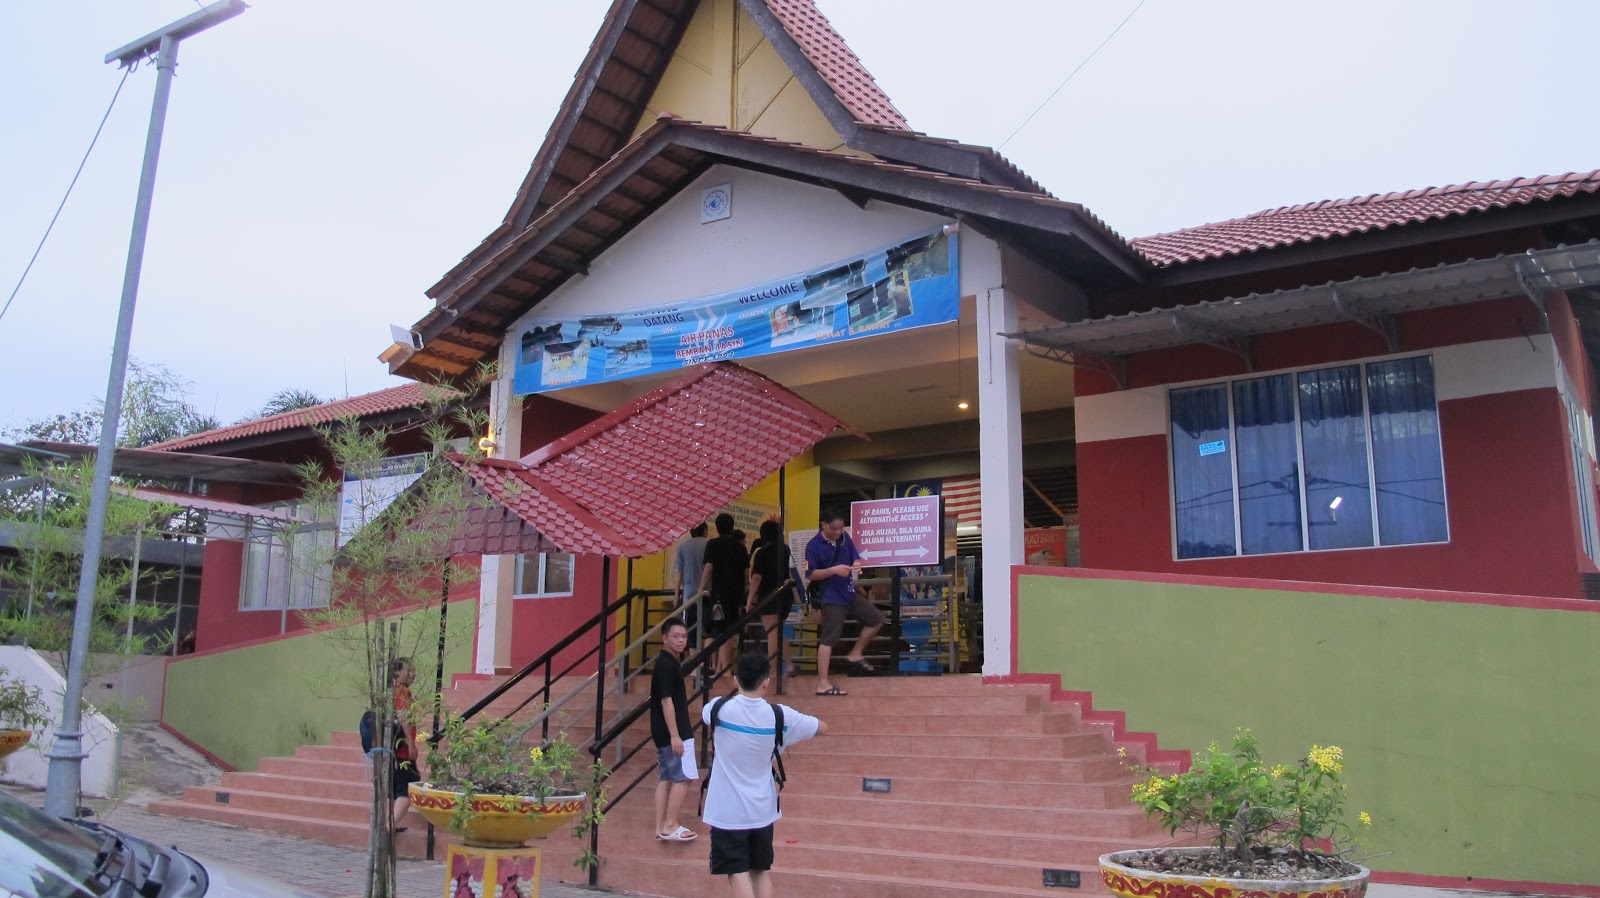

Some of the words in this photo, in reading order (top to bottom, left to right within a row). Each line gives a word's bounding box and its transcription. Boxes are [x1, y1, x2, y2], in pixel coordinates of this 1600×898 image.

[739, 281, 799, 305] WELCOME
[643, 313, 685, 328] DATANG
[680, 334, 697, 346] AIR
[698, 326, 735, 341] PANAS
[676, 346, 713, 359] BEMBAN
[715, 338, 744, 351] JASIN
[892, 505, 916, 514] PLEASE
[916, 504, 930, 512] USE
[859, 515, 899, 525] ALTERNATIVE
[899, 513, 924, 522] ACCESS
[861, 529, 875, 537] JIKA
[899, 526, 913, 534] SILA
[913, 525, 932, 533] GUNA
[861, 537, 884, 545] LALUAN
[885, 534, 922, 543] ALTERNATIF
